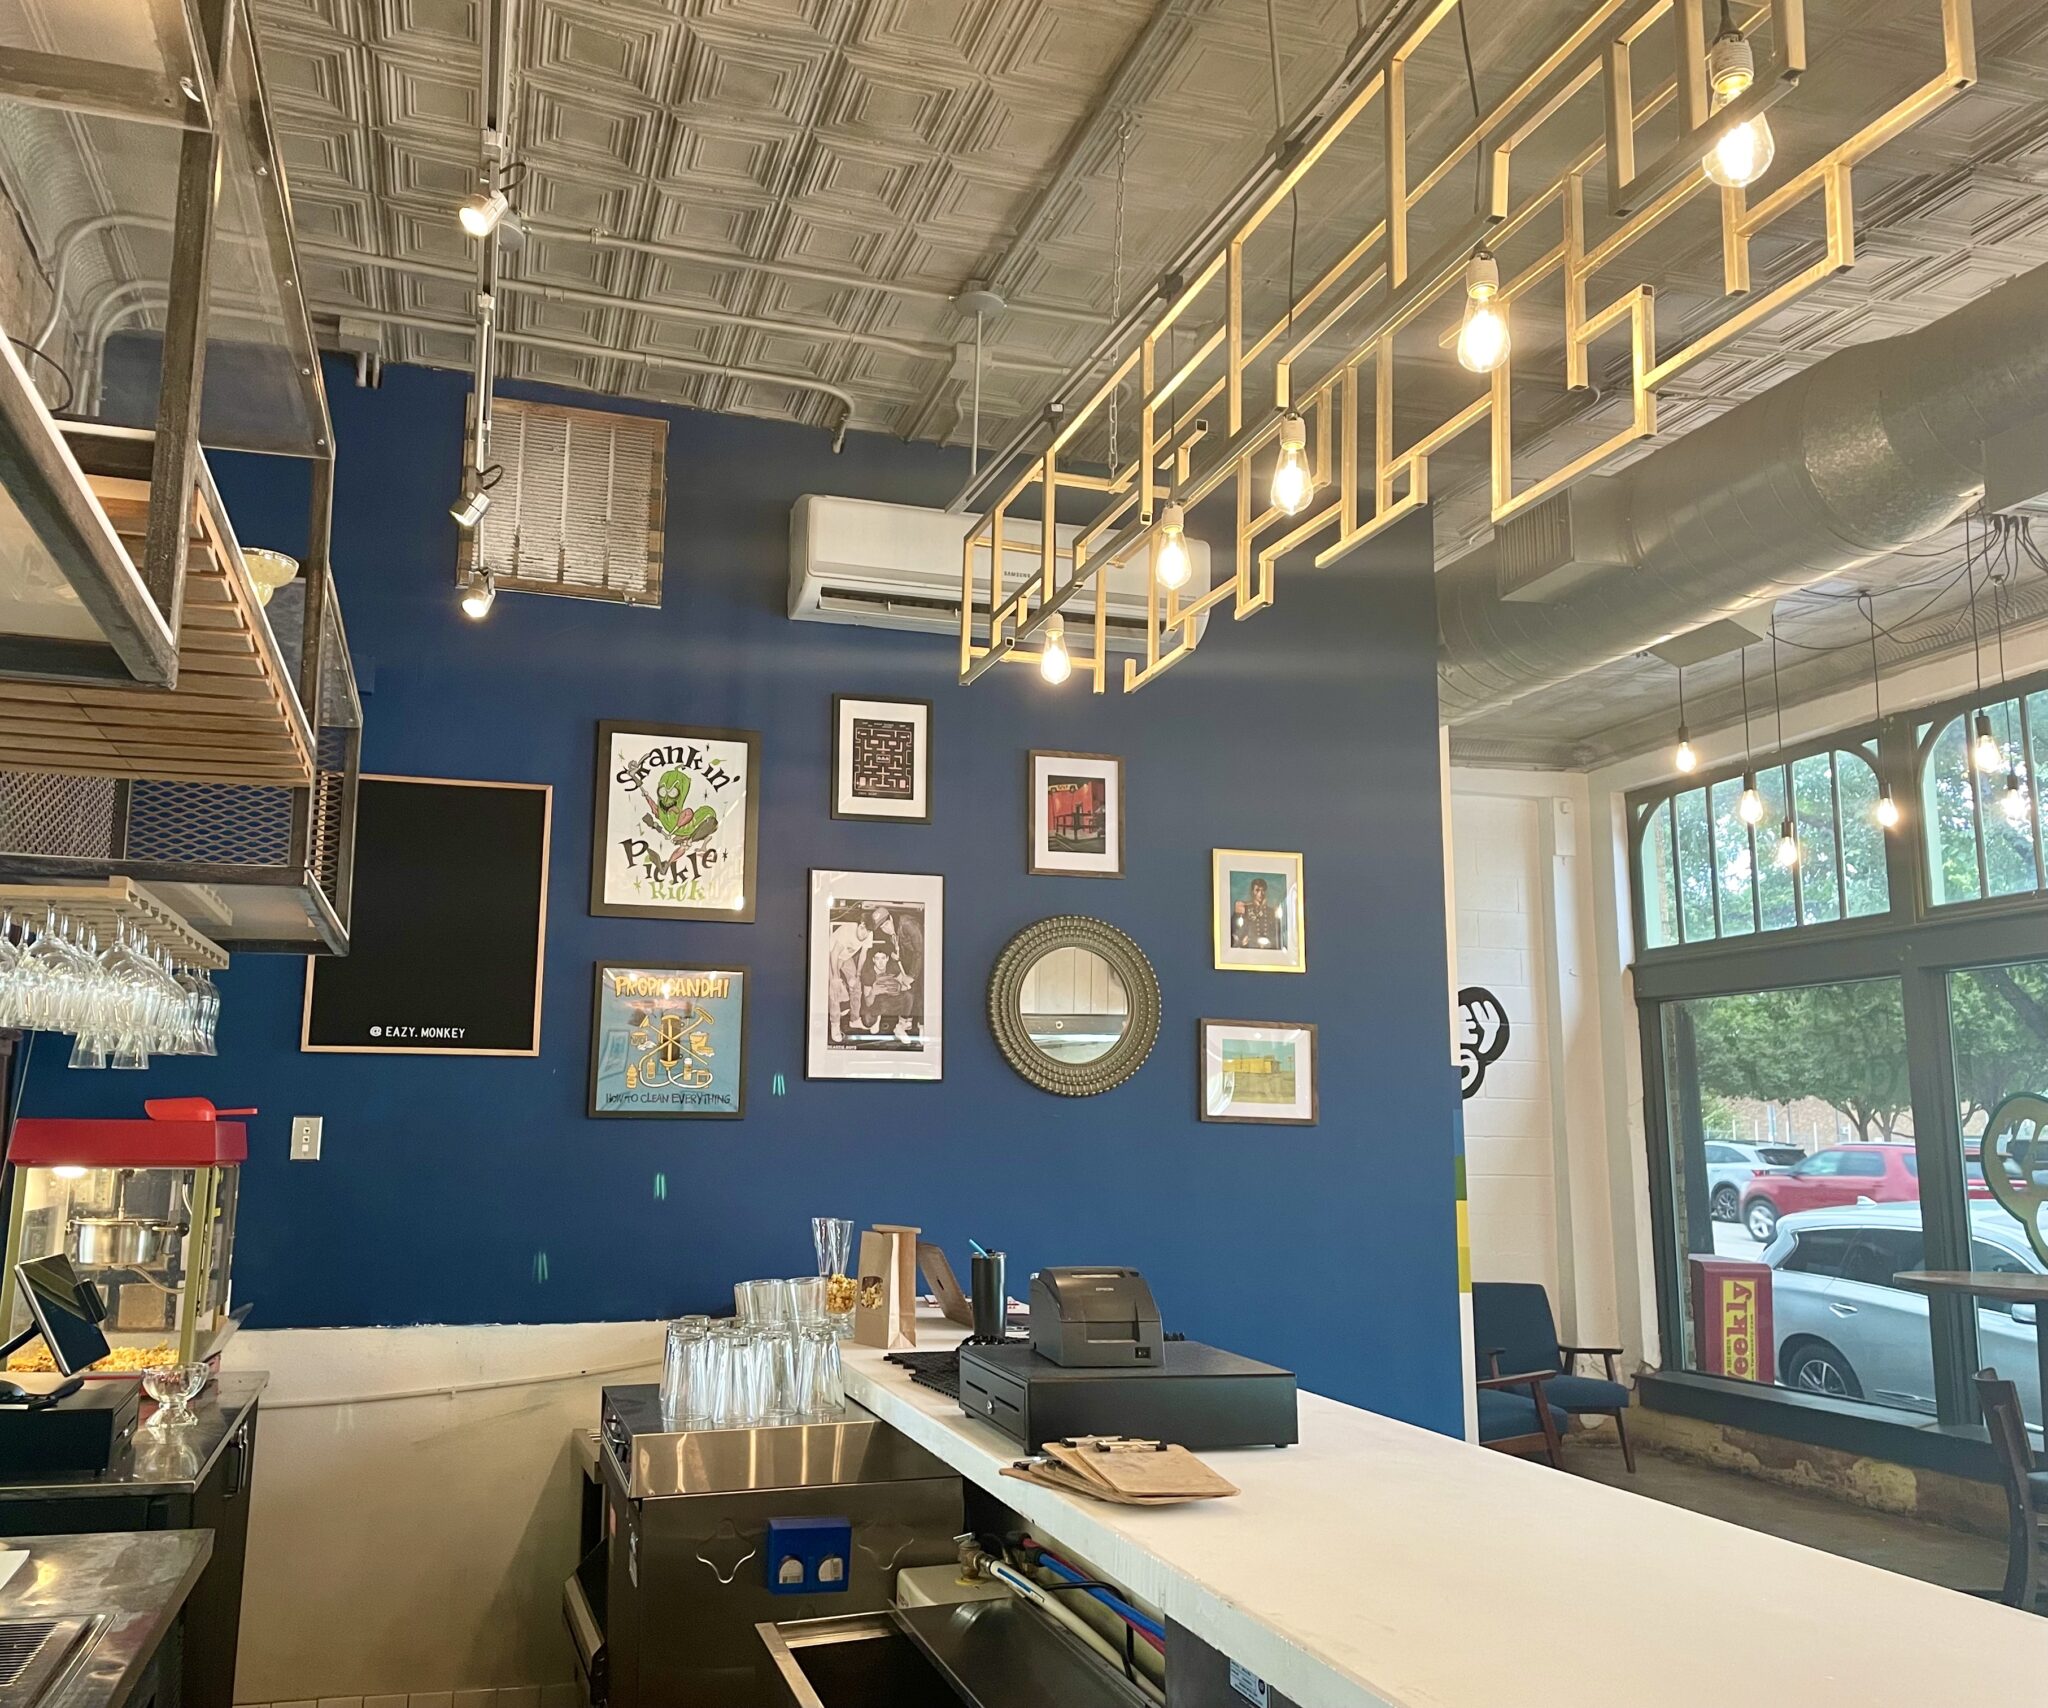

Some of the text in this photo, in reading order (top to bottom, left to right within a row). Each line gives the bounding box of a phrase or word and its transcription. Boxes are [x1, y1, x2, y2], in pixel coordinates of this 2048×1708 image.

[1003, 570, 1031, 578] SAMSUNG
[618, 838, 718, 885] Pickle
[624, 1093, 639, 1104] TO
[640, 1092, 670, 1104] CLEAN
[671, 1093, 731, 1105] EVERYTHING
